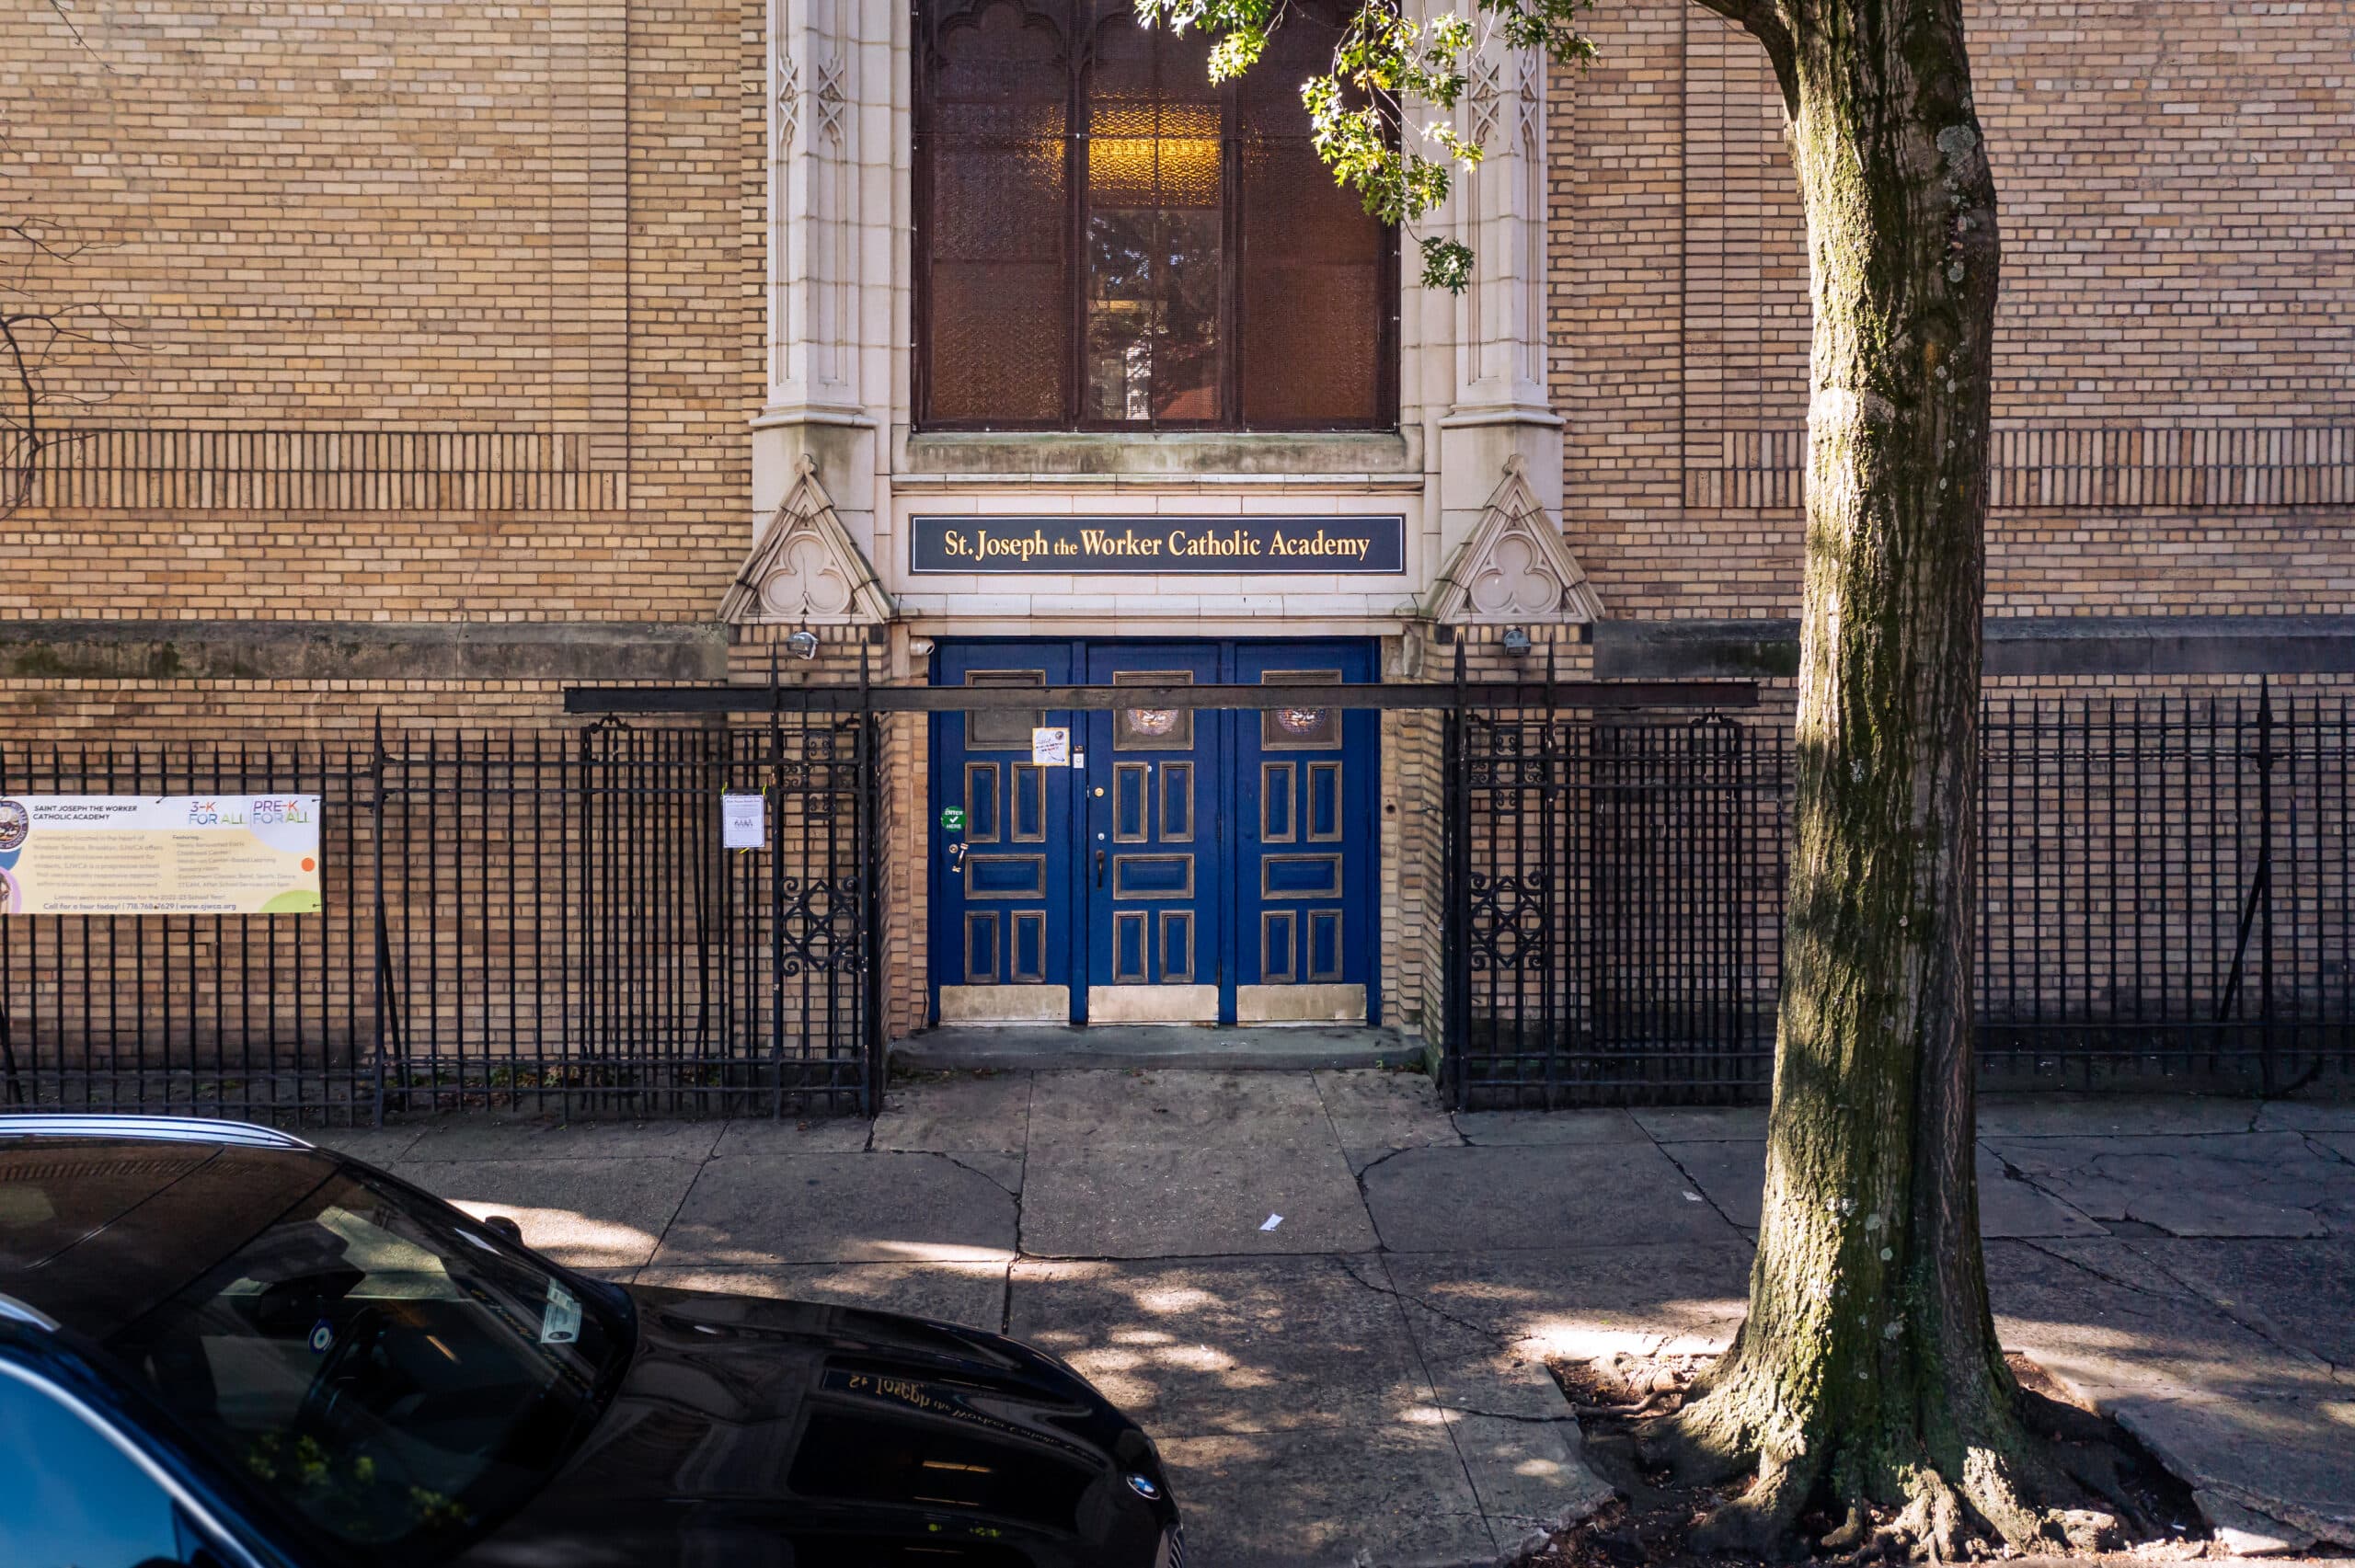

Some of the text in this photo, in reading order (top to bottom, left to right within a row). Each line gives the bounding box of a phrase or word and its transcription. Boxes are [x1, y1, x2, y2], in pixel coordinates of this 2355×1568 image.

[945, 529, 1371, 562] St. Joseph the Worker Catholic Academy
[190, 801, 217, 813] 3-K
[253, 799, 299, 813] PRE-K
[189, 813, 247, 825] FOR ALL
[253, 810, 312, 824] FOR ALL
